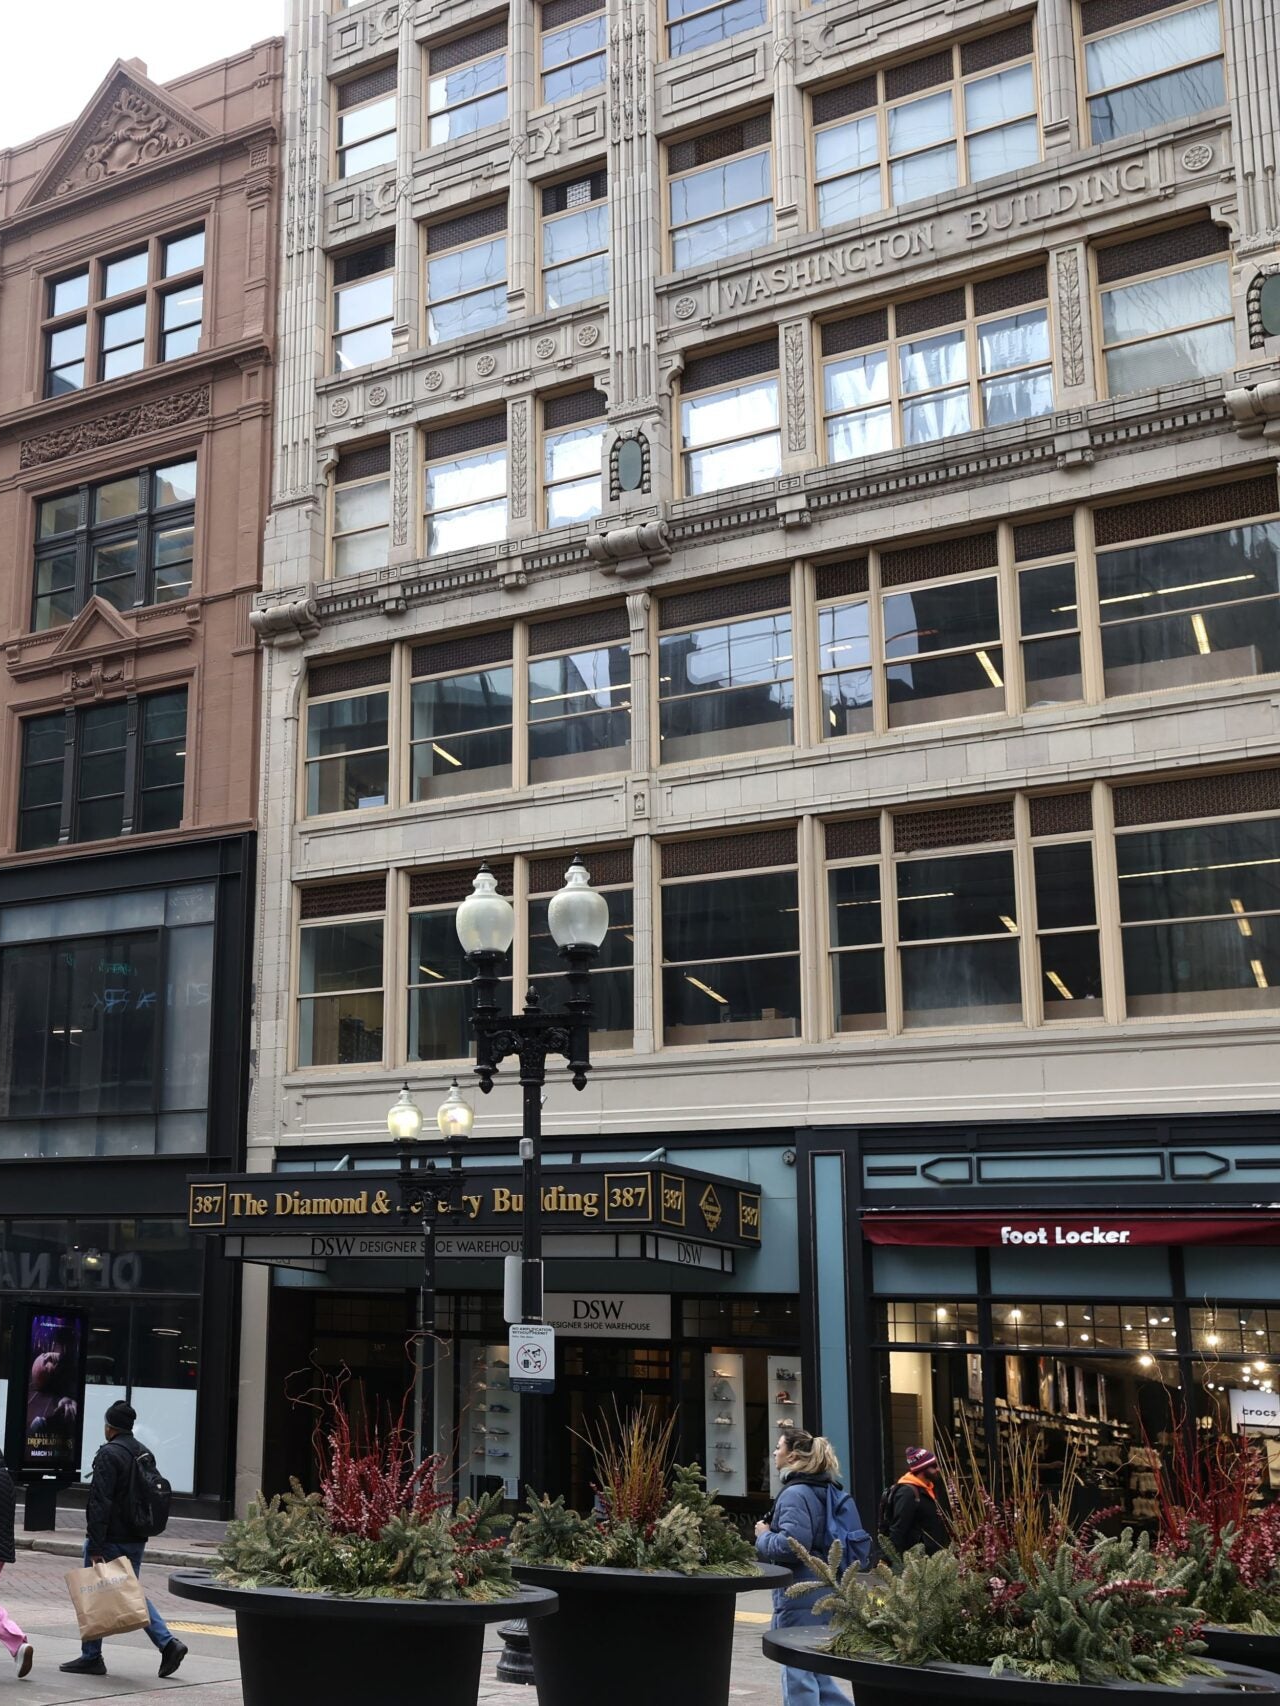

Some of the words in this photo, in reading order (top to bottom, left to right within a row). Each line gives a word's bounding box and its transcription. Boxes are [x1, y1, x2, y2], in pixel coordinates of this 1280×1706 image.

[722, 222, 935, 308] WASHINGTON
[965, 159, 1147, 241] BUILDING
[194, 1196, 222, 1213] 387
[230, 1193, 269, 1216] The
[274, 1190, 368, 1216] Diamond
[371, 1190, 391, 1214] &
[610, 1187, 646, 1208] 387
[663, 1189, 682, 1210] 387
[742, 1206, 758, 1226] 387
[1001, 1226, 1048, 1244] Foot
[311, 1237, 356, 1256] DSW
[360, 1241, 417, 1253] DESIGNER
[421, 1241, 453, 1252] SOE
[677, 1242, 703, 1264] DSW
[573, 1300, 624, 1319] DSW
[583, 1322, 603, 1330] SHOE
[605, 1322, 651, 1331] WAREHOUSE
[1242, 1408, 1277, 1417] crocs
